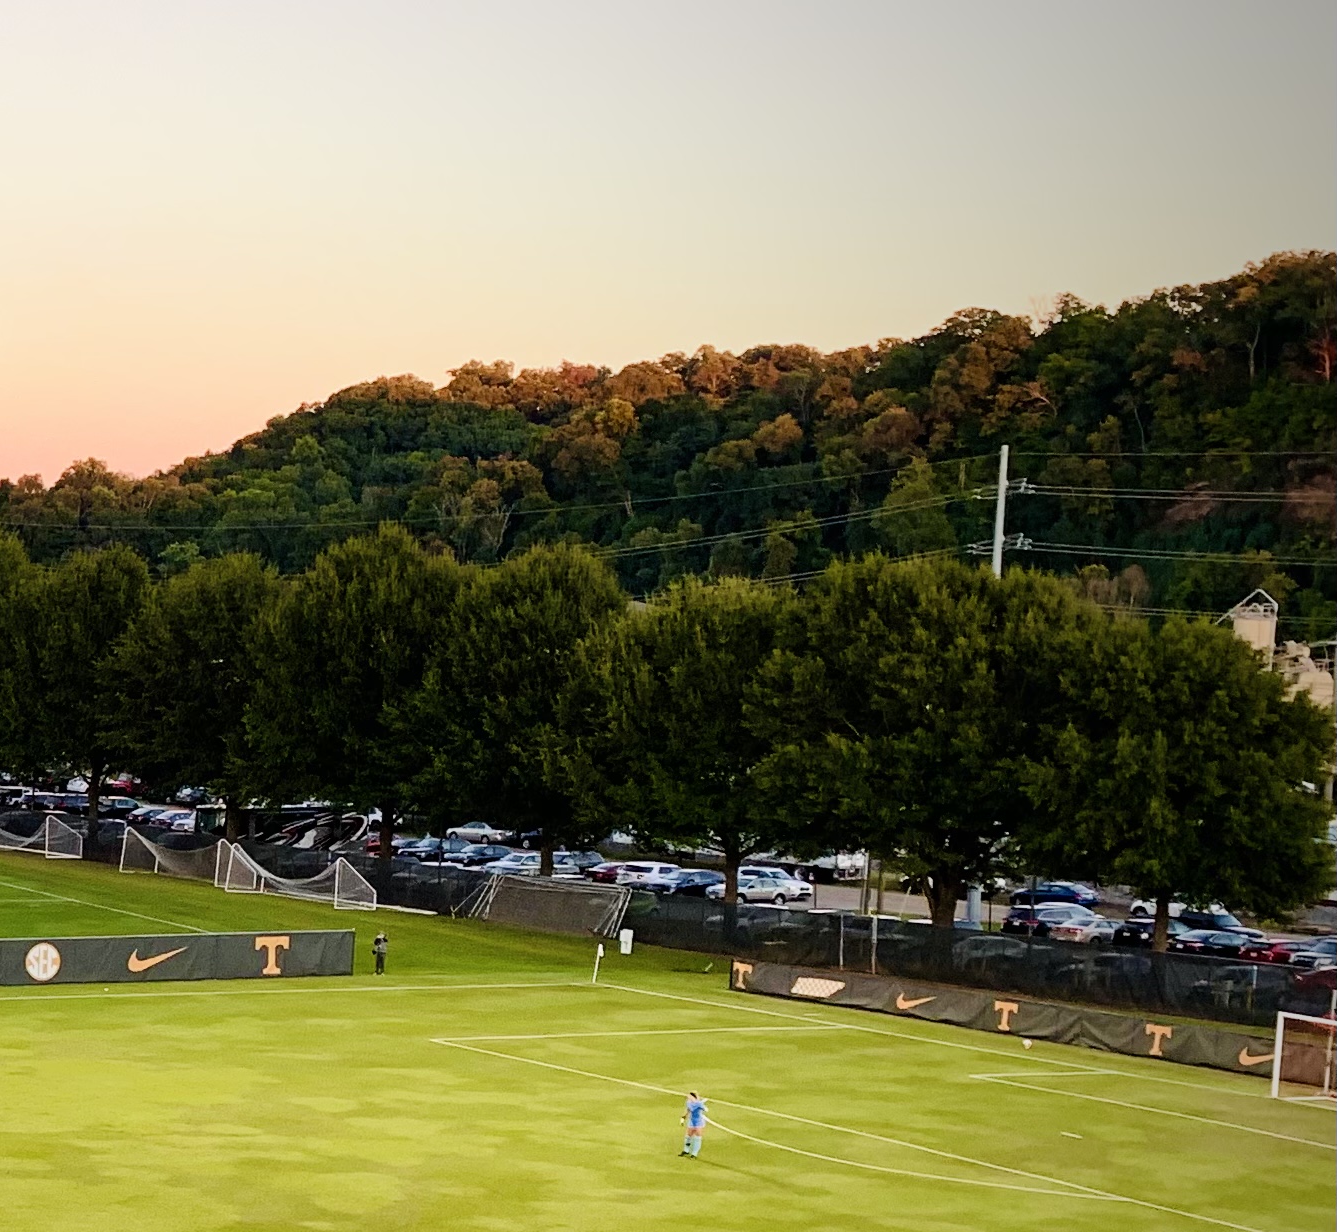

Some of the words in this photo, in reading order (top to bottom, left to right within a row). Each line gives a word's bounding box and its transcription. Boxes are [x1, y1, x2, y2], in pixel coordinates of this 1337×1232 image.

[27, 943, 60, 980] SEC
[255, 936, 290, 974] T
[733, 963, 753, 989] T
[995, 1001, 1019, 1031] T
[1145, 1024, 1172, 1056] T
